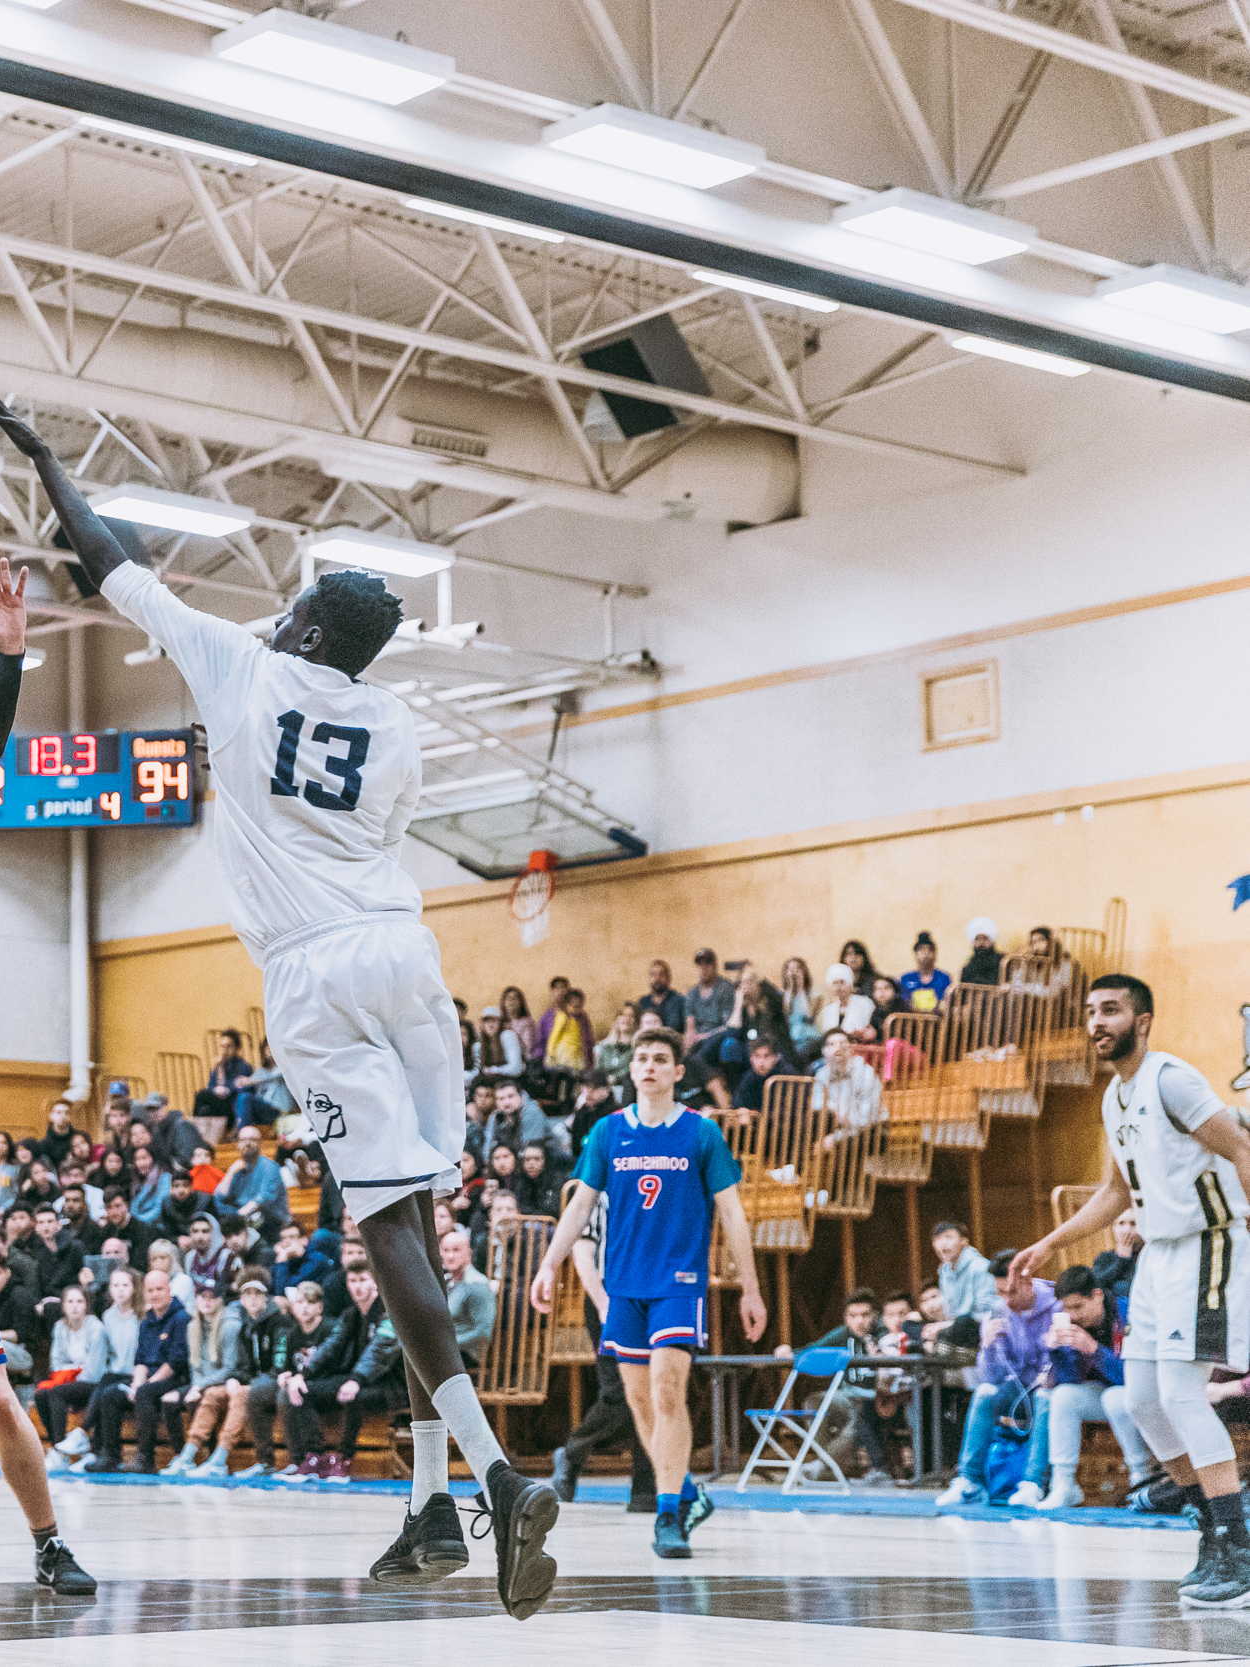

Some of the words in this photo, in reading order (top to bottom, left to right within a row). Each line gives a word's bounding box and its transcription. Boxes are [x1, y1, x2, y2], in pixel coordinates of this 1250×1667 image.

[29, 734, 97, 776] 18.3
[270, 709, 371, 812] 13
[137, 761, 189, 803] 94
[43, 797, 93, 819] period
[99, 791, 121, 821] 4
[637, 1174, 663, 1210] 9
